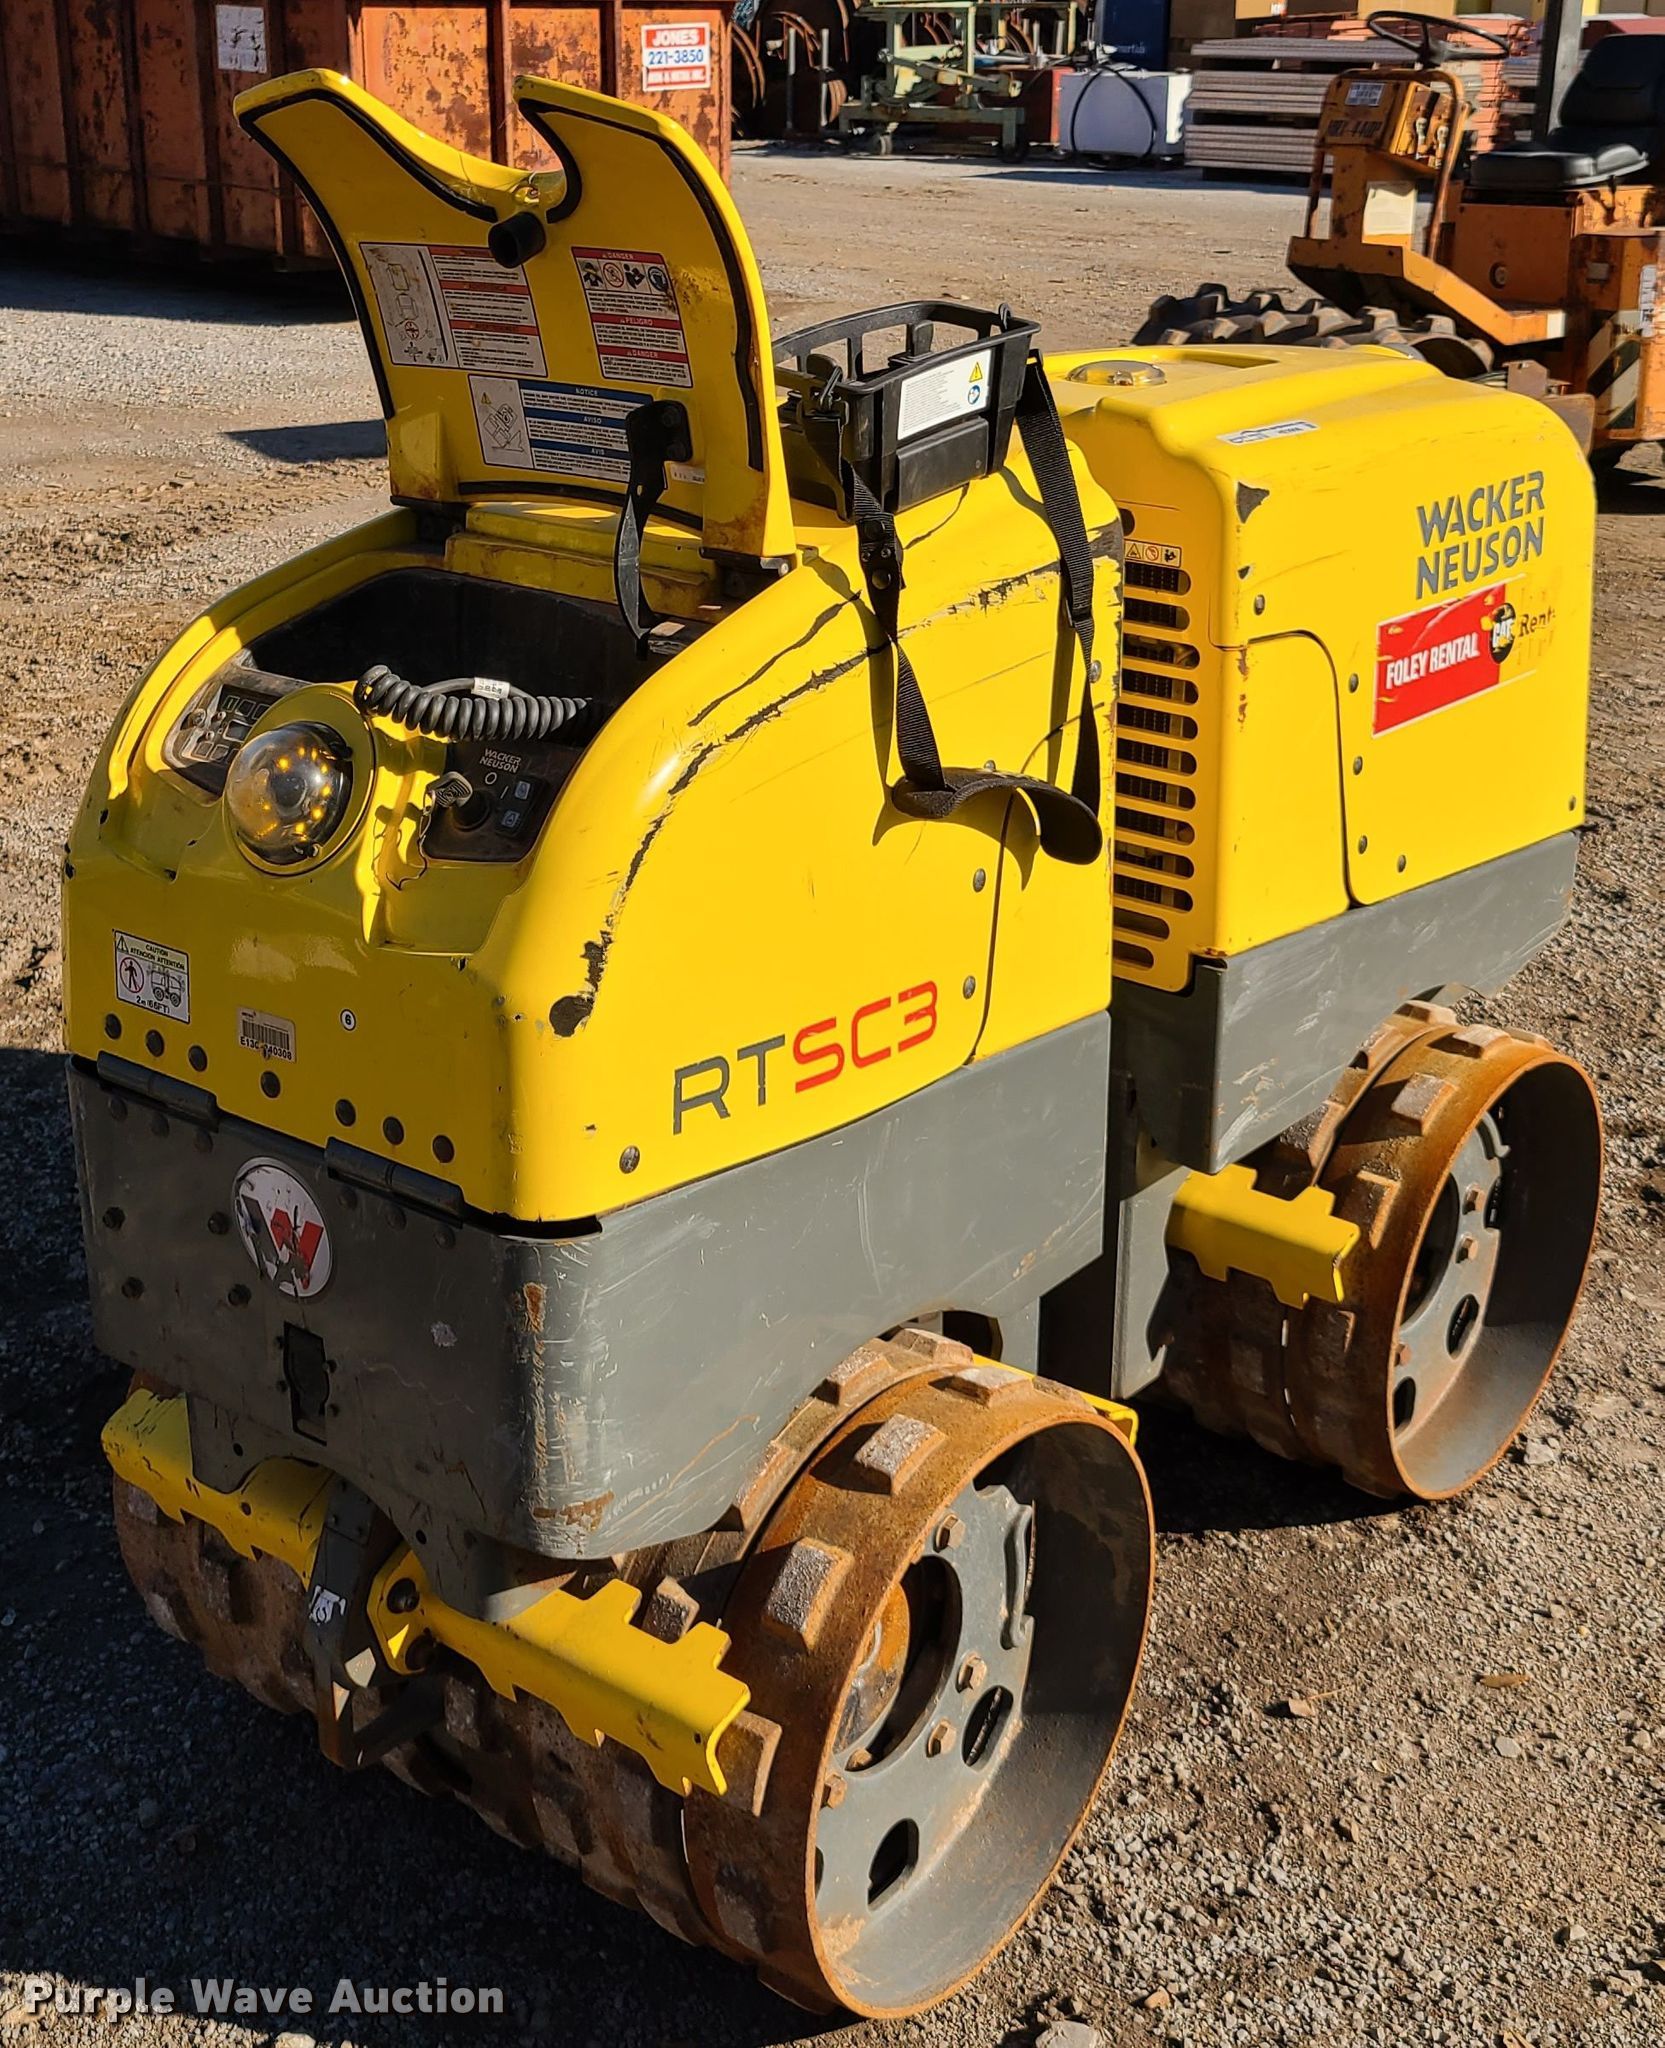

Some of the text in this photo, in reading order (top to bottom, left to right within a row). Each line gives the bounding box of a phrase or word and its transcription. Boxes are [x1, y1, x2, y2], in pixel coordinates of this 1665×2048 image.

[652, 28, 700, 47] JONES
[648, 49, 704, 65] 221-3850
[608, 252, 634, 260] DANGER
[625, 317, 653, 326] PELIGRO
[575, 388, 598, 397] NOTICE
[583, 416, 602, 425] AVISO
[591, 448, 605, 456] AVIS
[1416, 470, 1545, 548] WACKER
[1415, 516, 1544, 600] NEUSON
[1386, 631, 1480, 690] FOLEY RENTAL
[484, 748, 521, 766] WACKER
[480, 756, 519, 773] NEUSON
[145, 944, 169, 957] CAUTION
[157, 957, 185, 970] ATTENTION
[344, 1014, 352, 1026] 6
